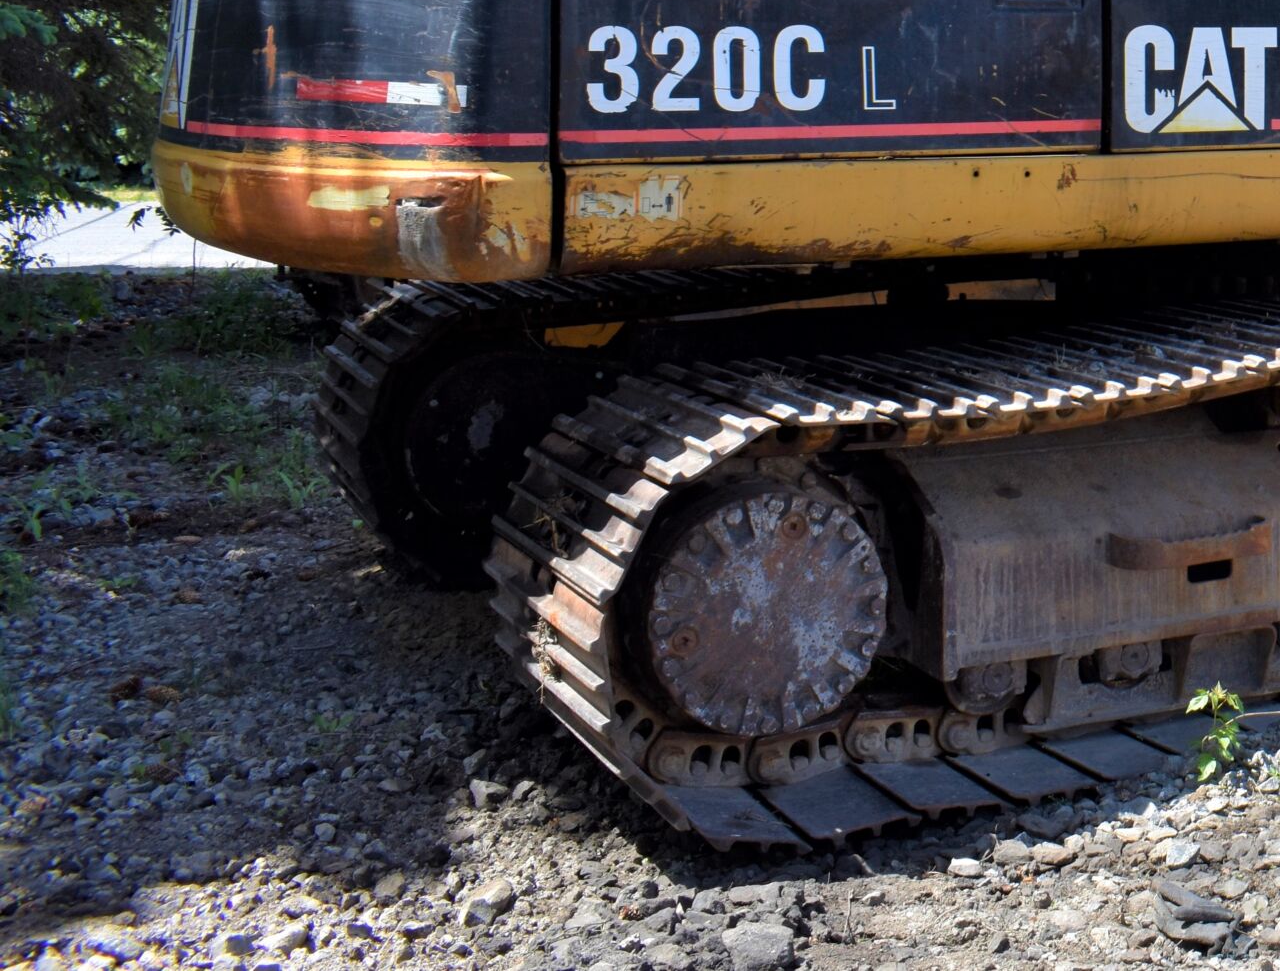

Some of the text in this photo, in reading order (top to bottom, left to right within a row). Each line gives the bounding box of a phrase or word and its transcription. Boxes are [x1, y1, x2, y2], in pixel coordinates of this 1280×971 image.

[586, 24, 897, 114] 320C L
[1124, 24, 1278, 134] CAT
